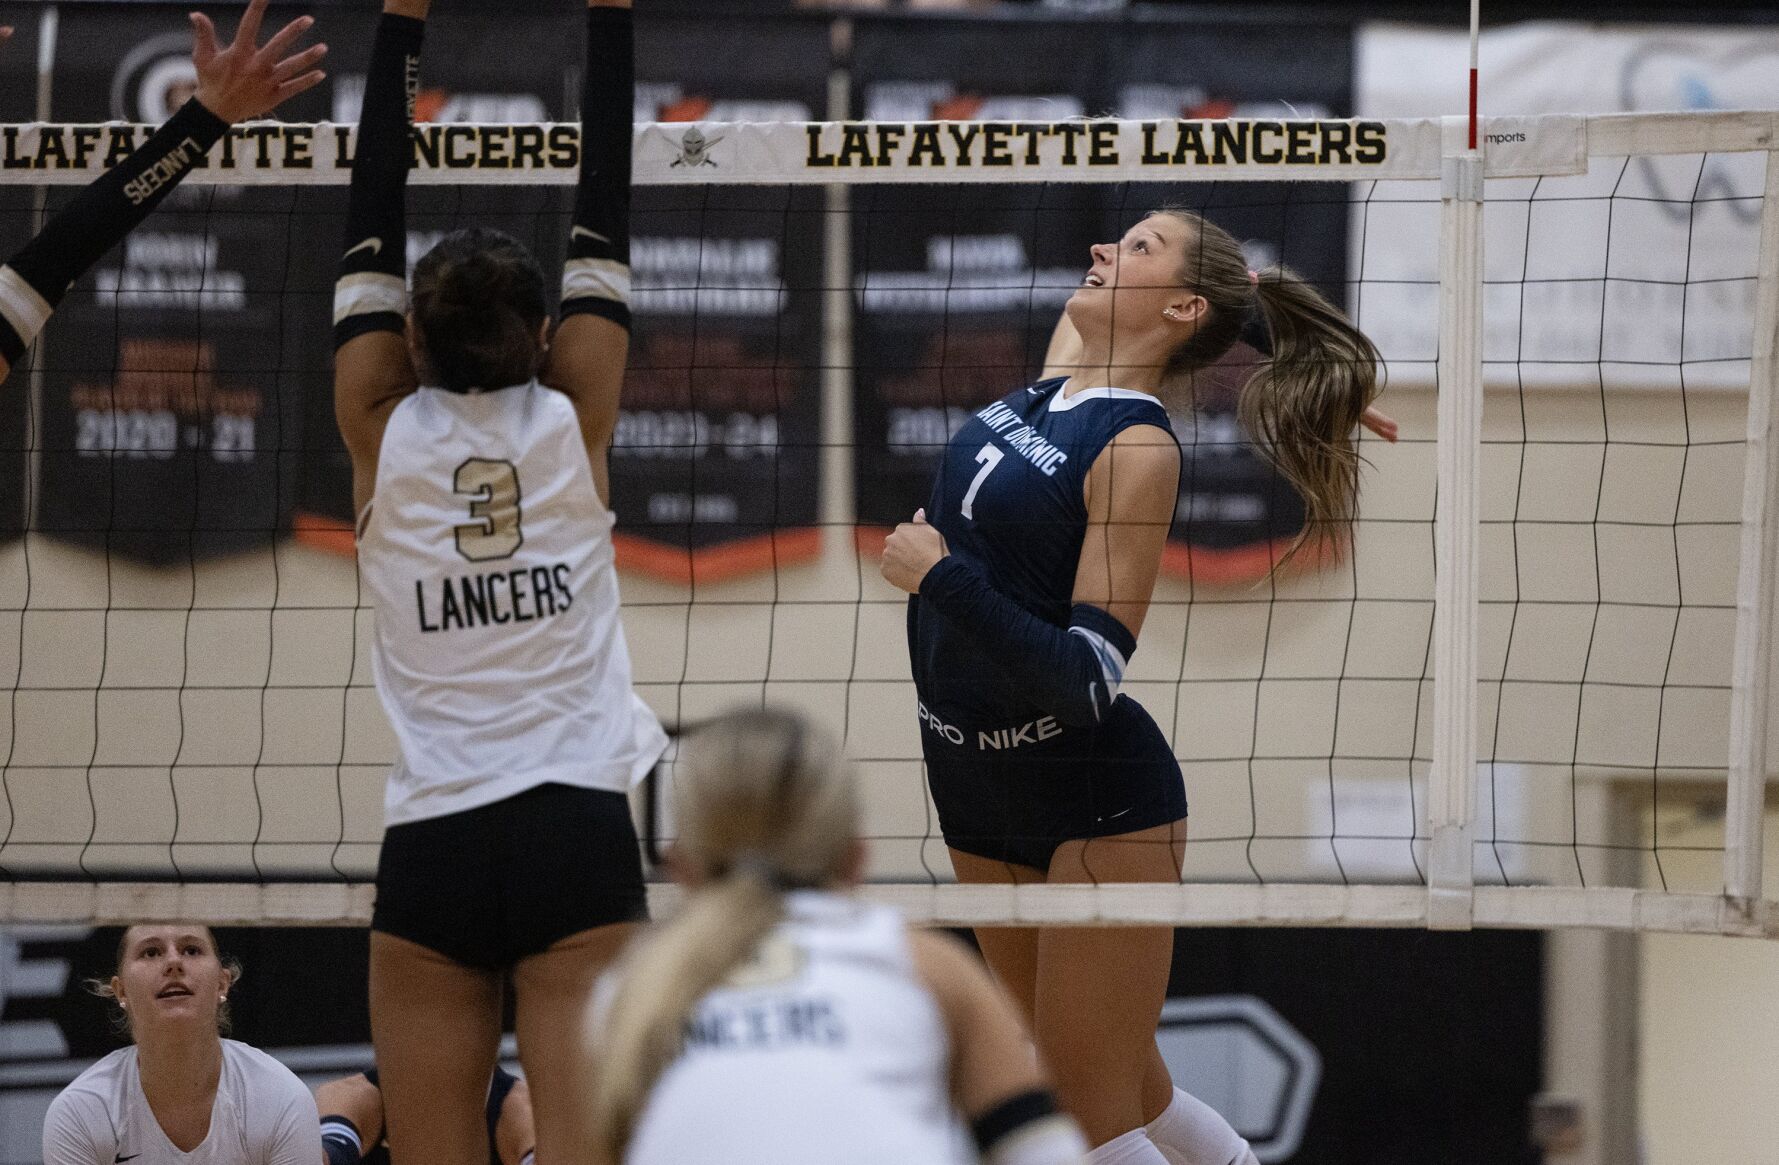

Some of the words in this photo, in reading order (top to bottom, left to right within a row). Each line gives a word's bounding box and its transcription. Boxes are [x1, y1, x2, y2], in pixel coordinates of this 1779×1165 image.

[4, 126, 313, 169] LAFATTE
[335, 126, 579, 169] LNCERS
[123, 137, 202, 205] LANCERS
[806, 123, 1118, 167] LAFAYETTE
[1141, 122, 1386, 165] LANCERS
[453, 456, 524, 563] 3
[961, 441, 1005, 521] 7
[416, 563, 573, 633] LANCERS
[918, 701, 965, 745] PRO
[978, 715, 1063, 751] NIKE
